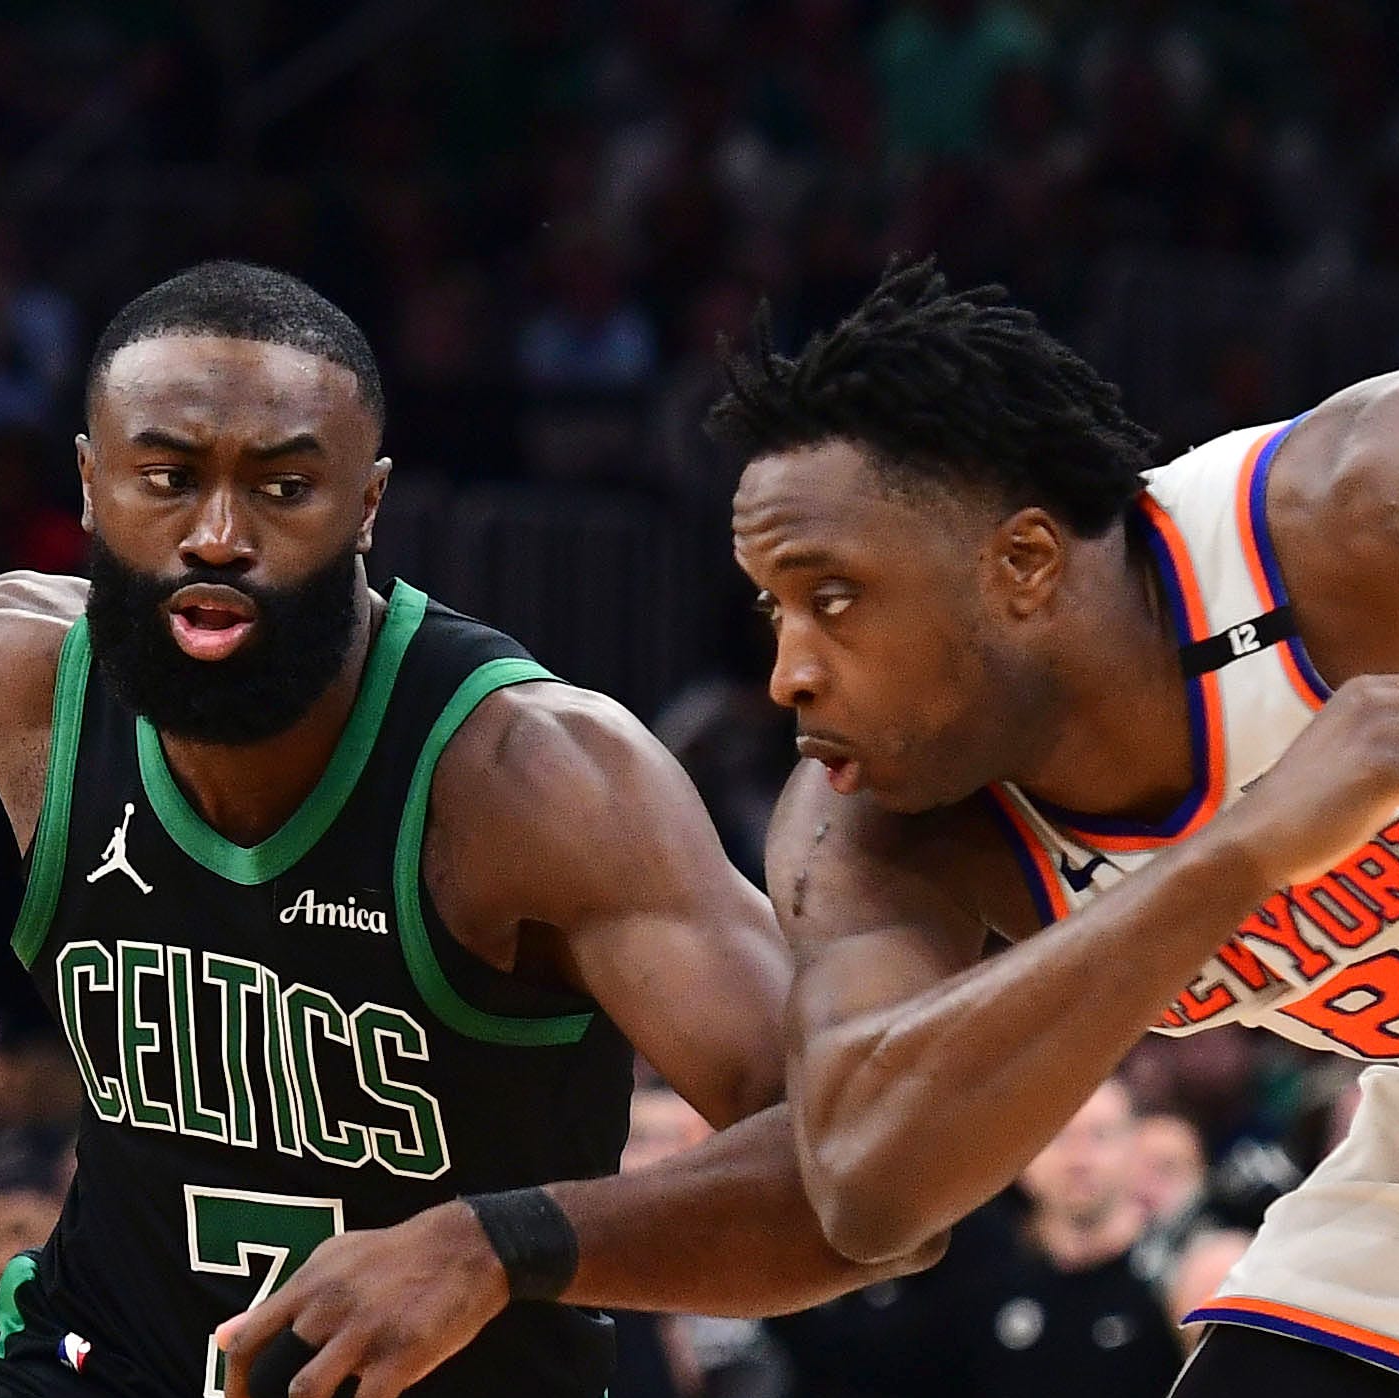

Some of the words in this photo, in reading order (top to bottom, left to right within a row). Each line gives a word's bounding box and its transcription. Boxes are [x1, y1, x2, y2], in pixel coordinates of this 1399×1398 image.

[1228, 623, 1261, 656] 12
[279, 889, 388, 934] Amica
[56, 939, 451, 1181] CELTICS
